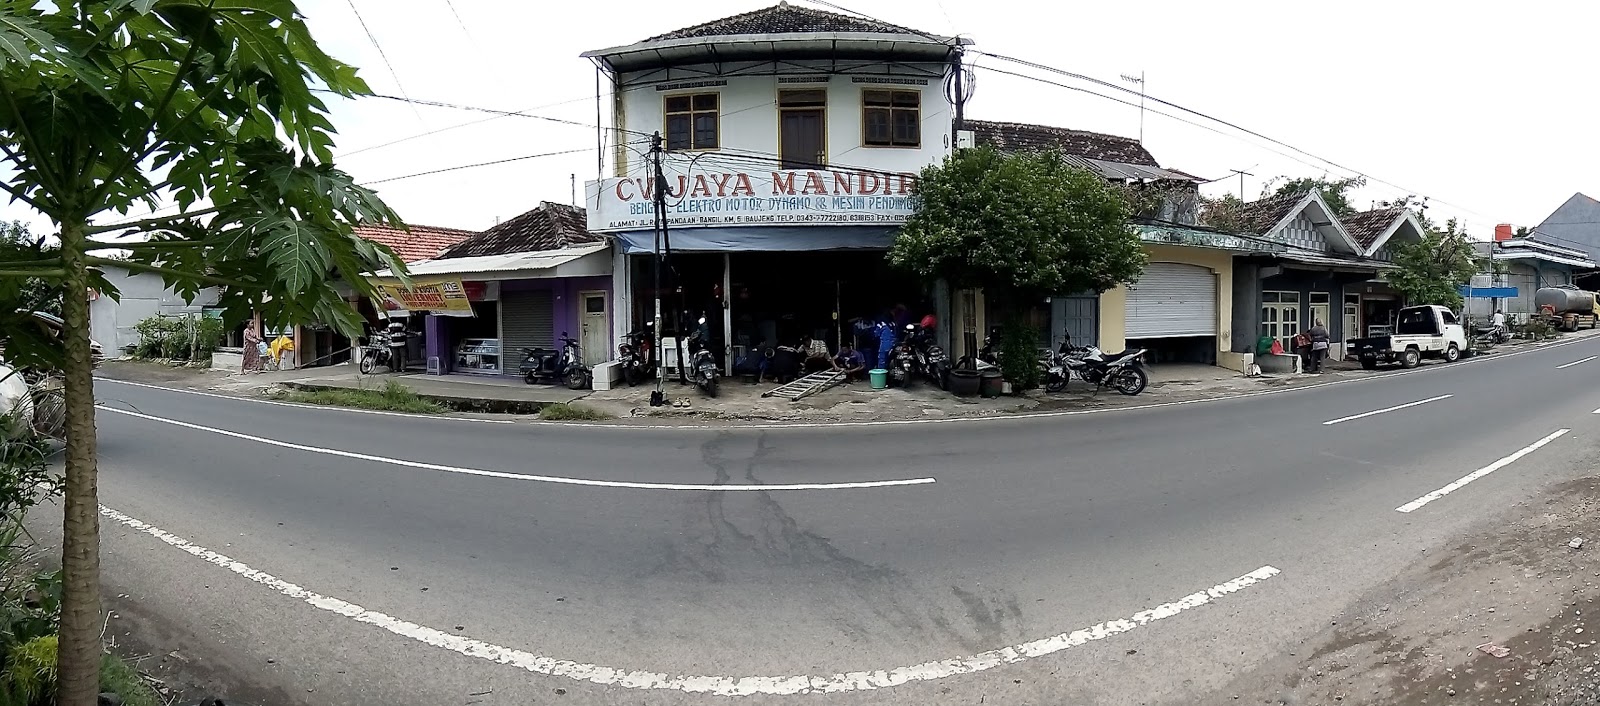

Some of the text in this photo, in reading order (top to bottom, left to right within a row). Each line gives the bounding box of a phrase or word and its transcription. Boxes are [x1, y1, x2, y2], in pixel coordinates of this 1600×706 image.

[669, 173, 755, 199] JAYA
[630, 201, 672, 215] BENGL
[676, 199, 721, 213] ELEKTRO
[769, 197, 811, 211] DYNAMO
[832, 196, 865, 210] MESIN
